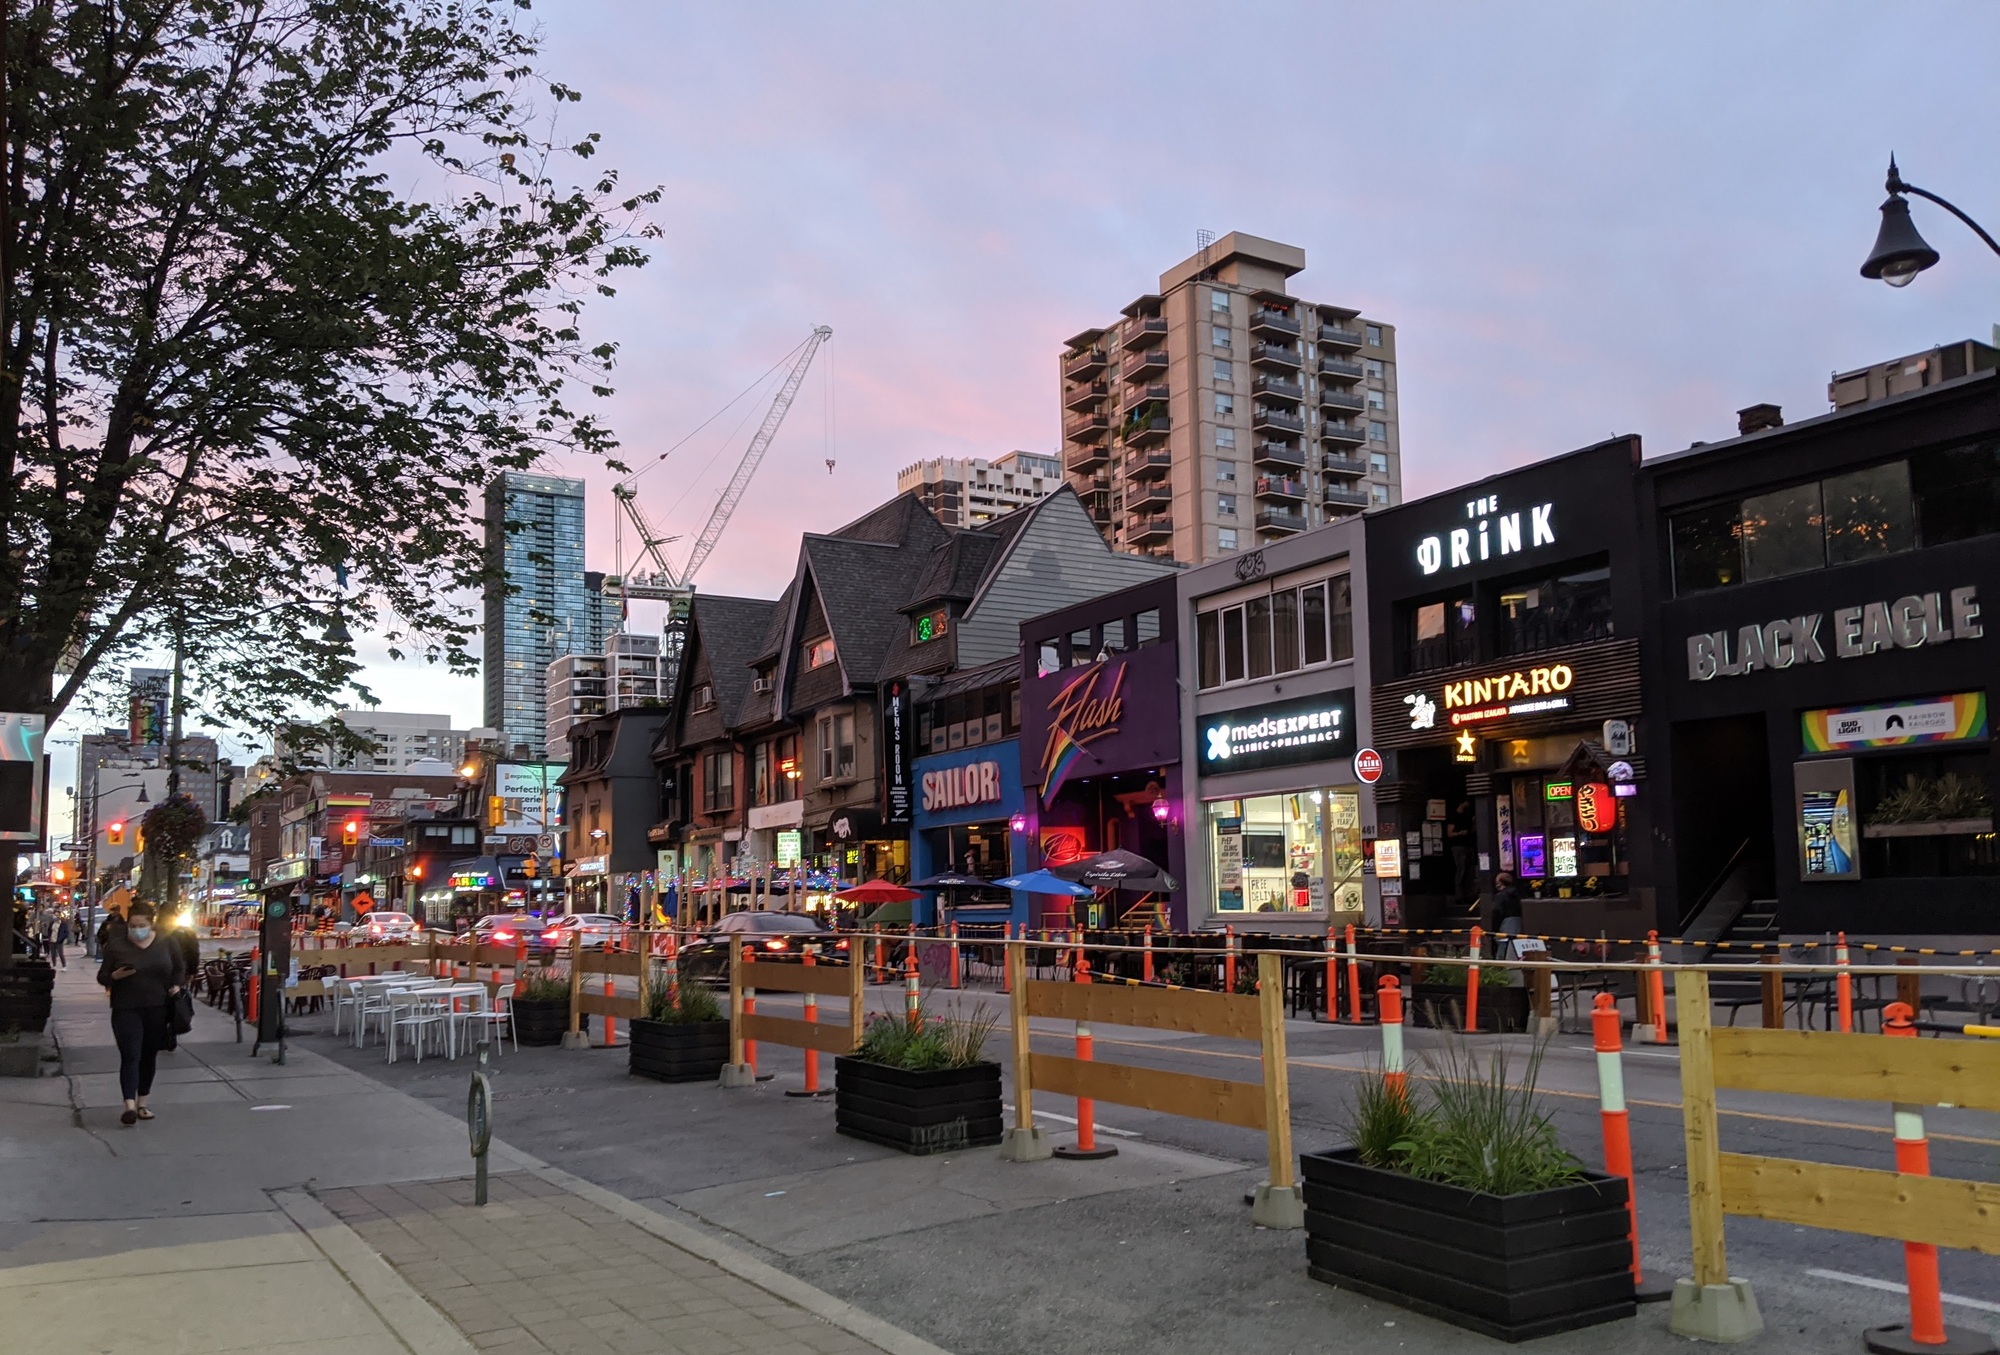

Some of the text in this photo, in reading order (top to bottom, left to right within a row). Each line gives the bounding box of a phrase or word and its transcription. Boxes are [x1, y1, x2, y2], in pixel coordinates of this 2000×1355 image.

[1467, 495, 1498, 518] THE
[1687, 585, 1984, 681] BLACK EAGLE
[1444, 664, 1573, 709] KINTARO
[892, 697, 900, 741] MEN'S
[1041, 661, 1127, 770] Flash
[1231, 710, 1342, 742] medsEXPERT
[1908, 711, 1946, 720] RAINBOW
[1838, 726, 1862, 734] LIGHT
[1232, 743, 1270, 755] CLINIC
[1277, 730, 1341, 748] PHARMACY
[894, 744, 902, 785] ROOM
[504, 785, 543, 795] Perfectly
[922, 761, 1000, 810] SAILOR
[1550, 787, 1572, 796] OPEN
[1362, 825, 1375, 834] 461
[1045, 833, 1077, 861] Flash
[1553, 840, 1575, 852] PATIO
[448, 877, 495, 887] GARAGE
[1251, 879, 1267, 890] FREE
[374, 890, 385, 898] 40
